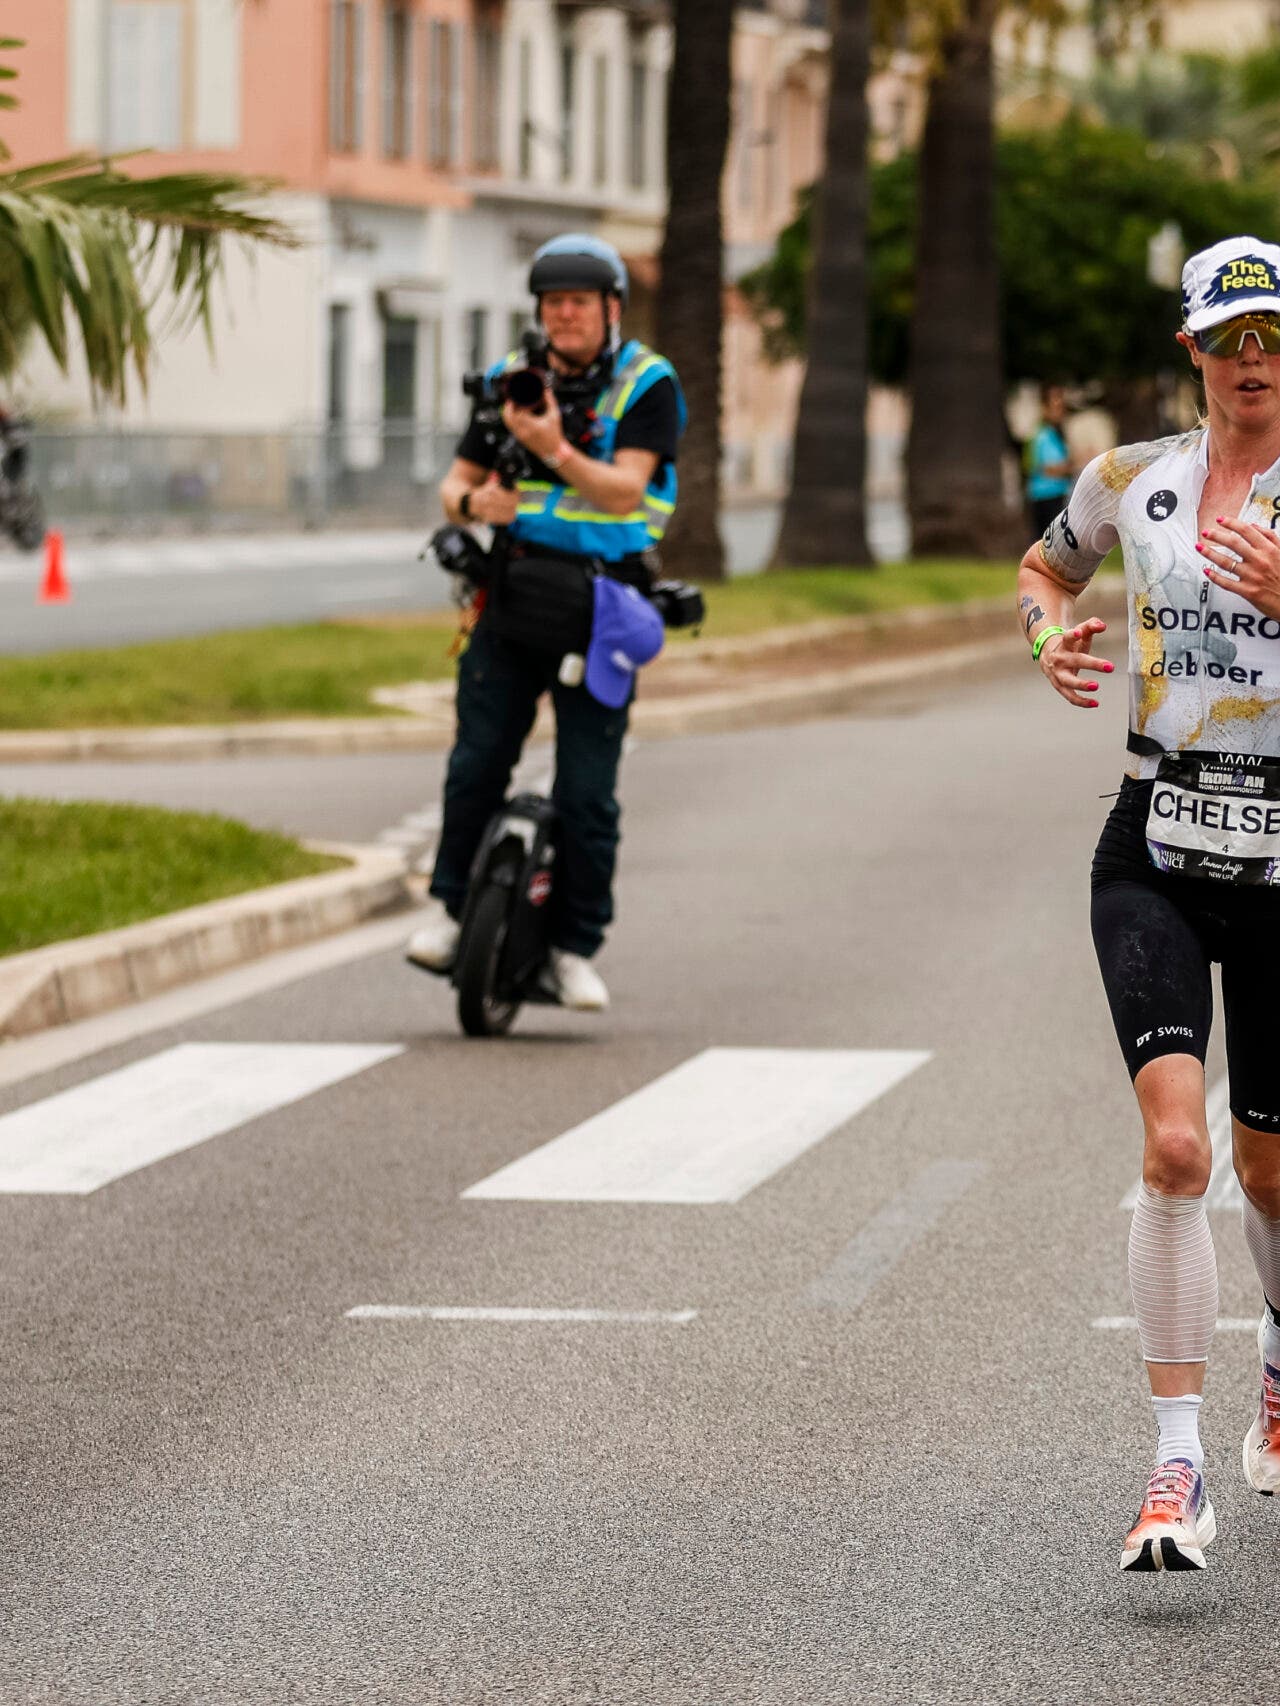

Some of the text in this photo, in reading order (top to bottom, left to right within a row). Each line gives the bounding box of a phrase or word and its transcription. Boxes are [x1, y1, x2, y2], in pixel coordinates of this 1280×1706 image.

[1227, 260, 1265, 276] The
[1222, 274, 1275, 292] Feed.
[1150, 650, 1263, 686] deboer
[1198, 783, 1263, 794] WORLD CHAMPIONSHIP
[1222, 844, 1229, 853] 4
[1160, 856, 1185, 869] NICE
[1208, 871, 1221, 879] NEW
[1136, 1026, 1193, 1047] DT SWISS
[1247, 1110, 1268, 1119] DT
